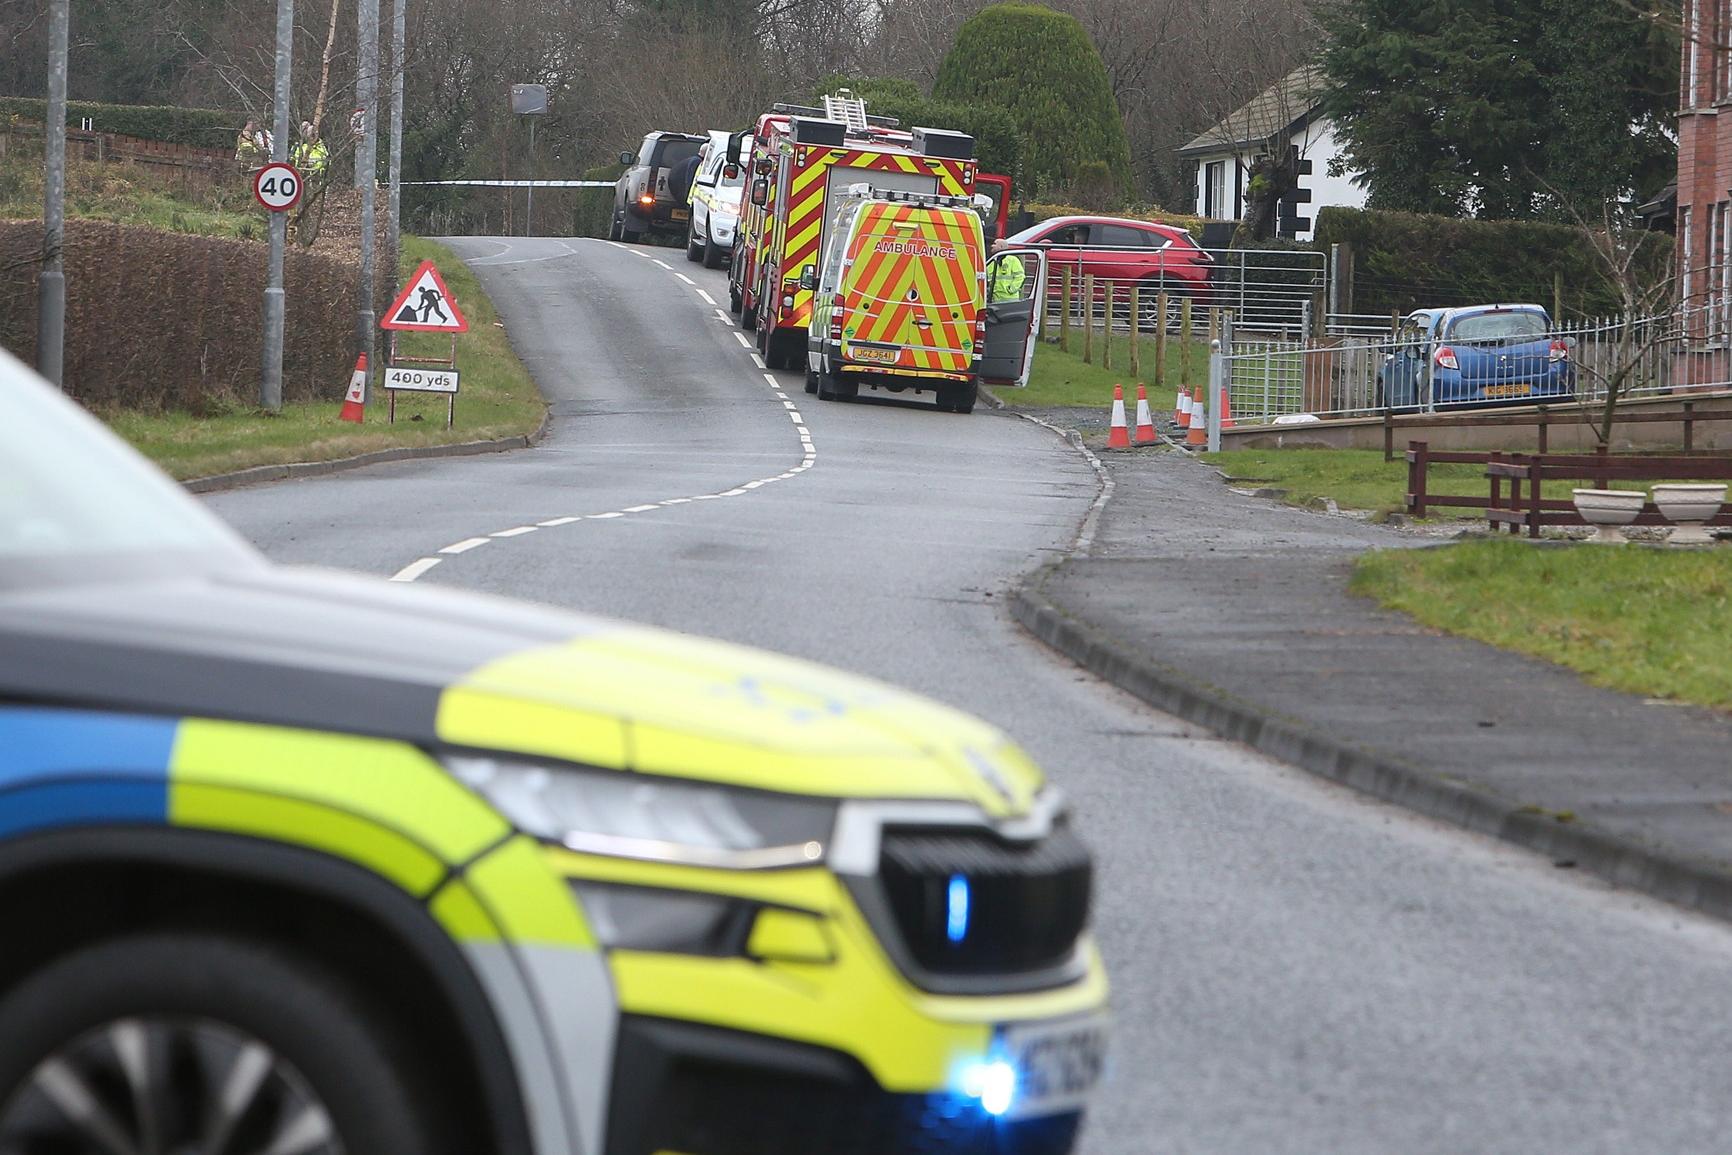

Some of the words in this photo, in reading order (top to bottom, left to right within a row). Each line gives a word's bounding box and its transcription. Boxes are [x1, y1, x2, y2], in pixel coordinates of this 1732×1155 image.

[261, 177, 296, 197] 40
[874, 241, 957, 259] AMBULANCE
[392, 372, 422, 384] 400
[427, 375, 450, 387] yds
